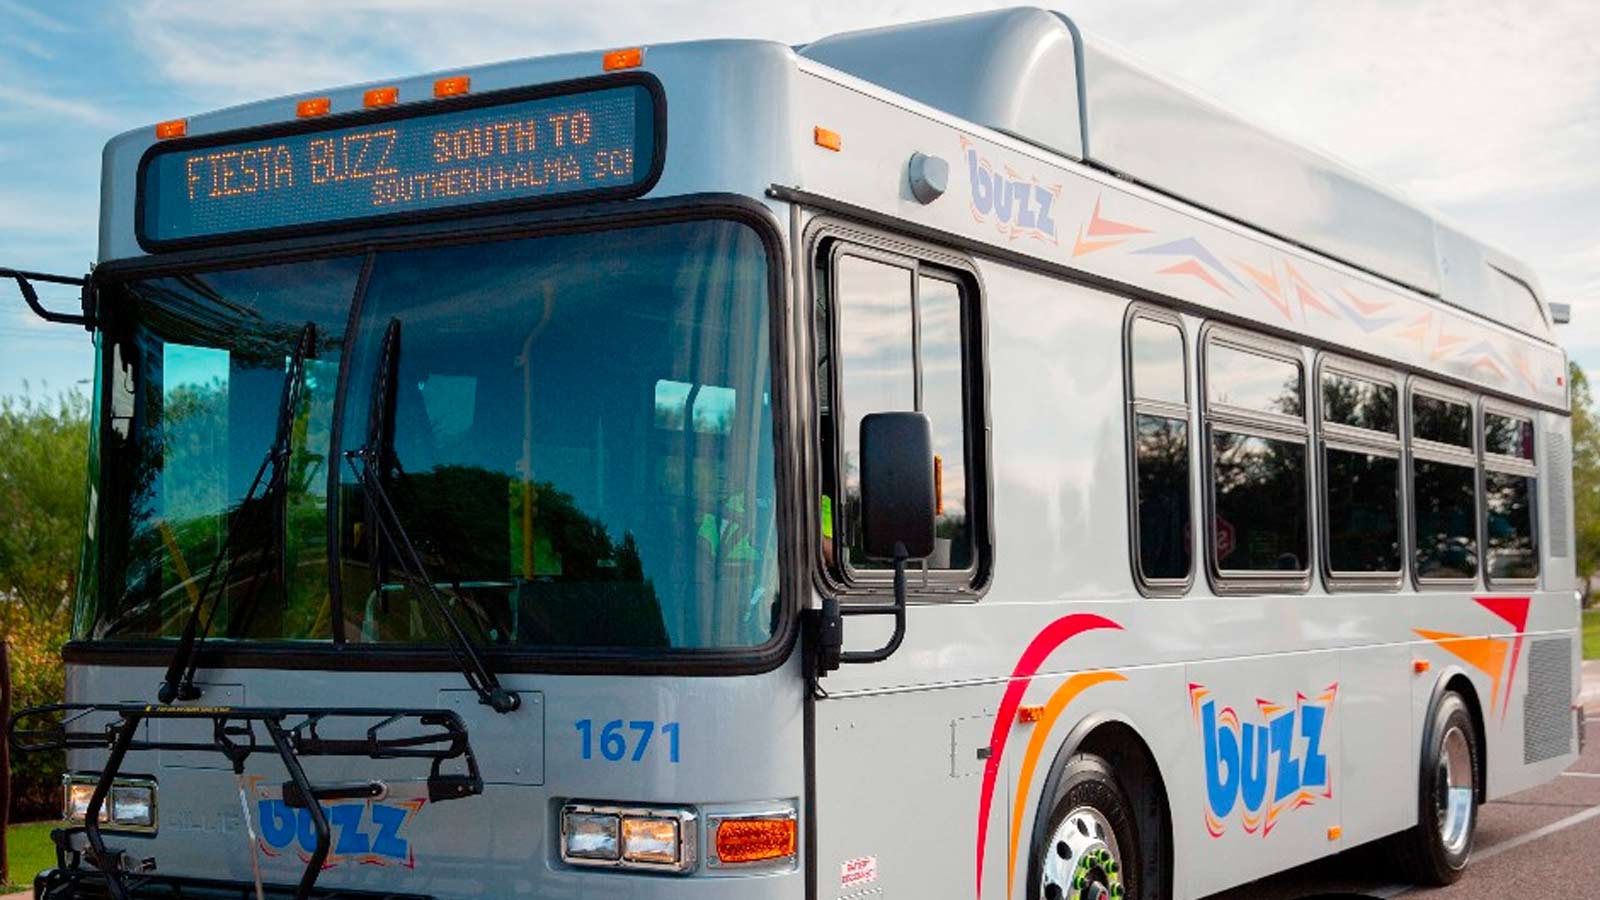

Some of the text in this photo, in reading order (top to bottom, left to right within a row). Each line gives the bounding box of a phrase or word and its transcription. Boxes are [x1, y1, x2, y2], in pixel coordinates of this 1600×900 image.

[433, 110, 591, 163] SOUTH TO
[186, 129, 398, 200] FIESTA BUZZ
[575, 719, 679, 764] 1671
